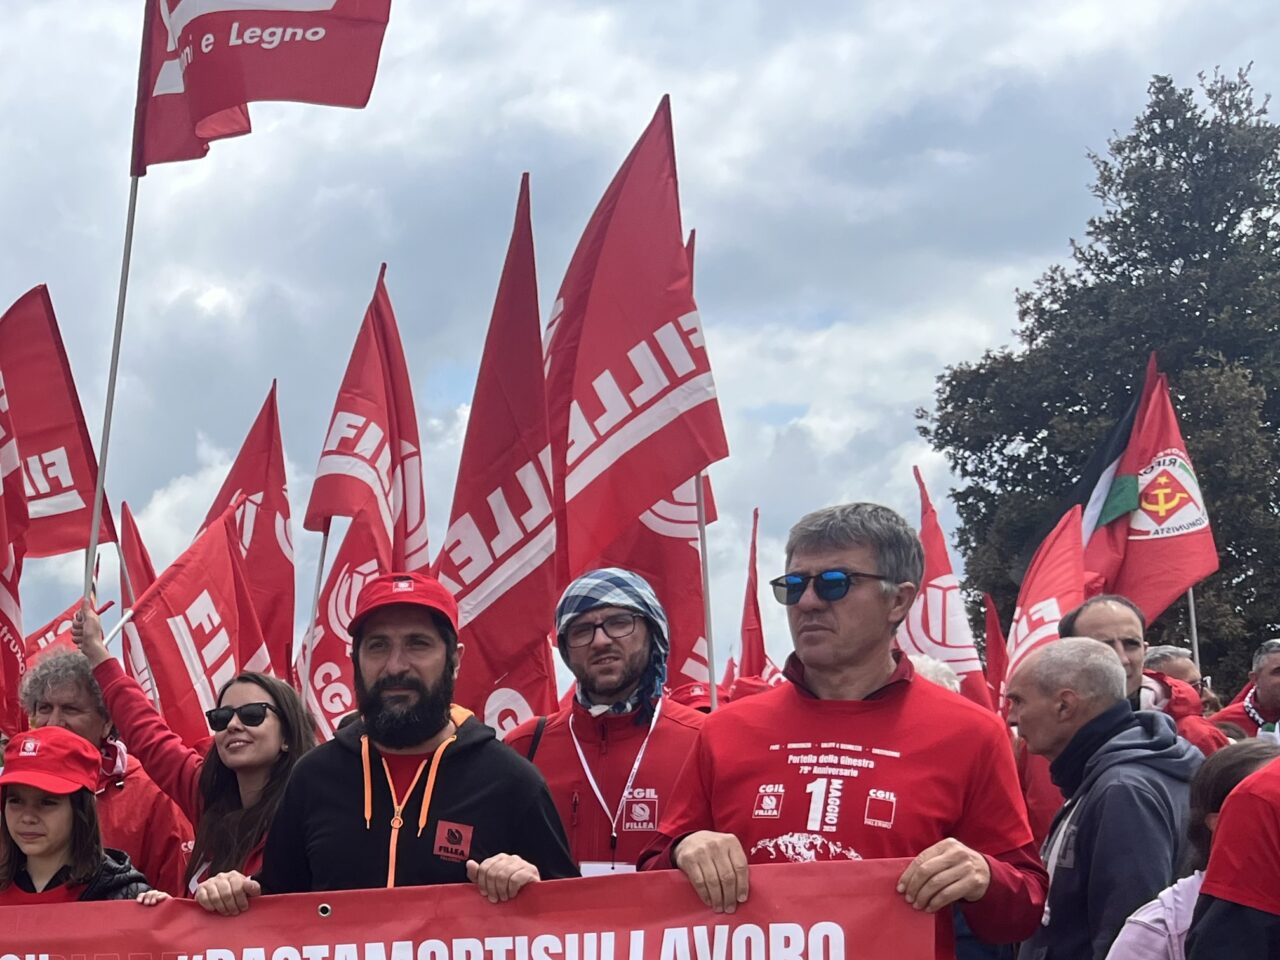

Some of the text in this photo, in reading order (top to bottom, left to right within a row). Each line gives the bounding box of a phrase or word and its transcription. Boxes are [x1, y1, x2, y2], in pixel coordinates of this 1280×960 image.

[201, 33, 215, 54] e
[228, 21, 327, 50] Legno
[758, 783, 786, 793] CGIL
[868, 788, 897, 801] CGIL
[824, 778, 844, 825] MAGGIO
[625, 821, 655, 830] FILLEA
[438, 845, 465, 857] FILLEA
